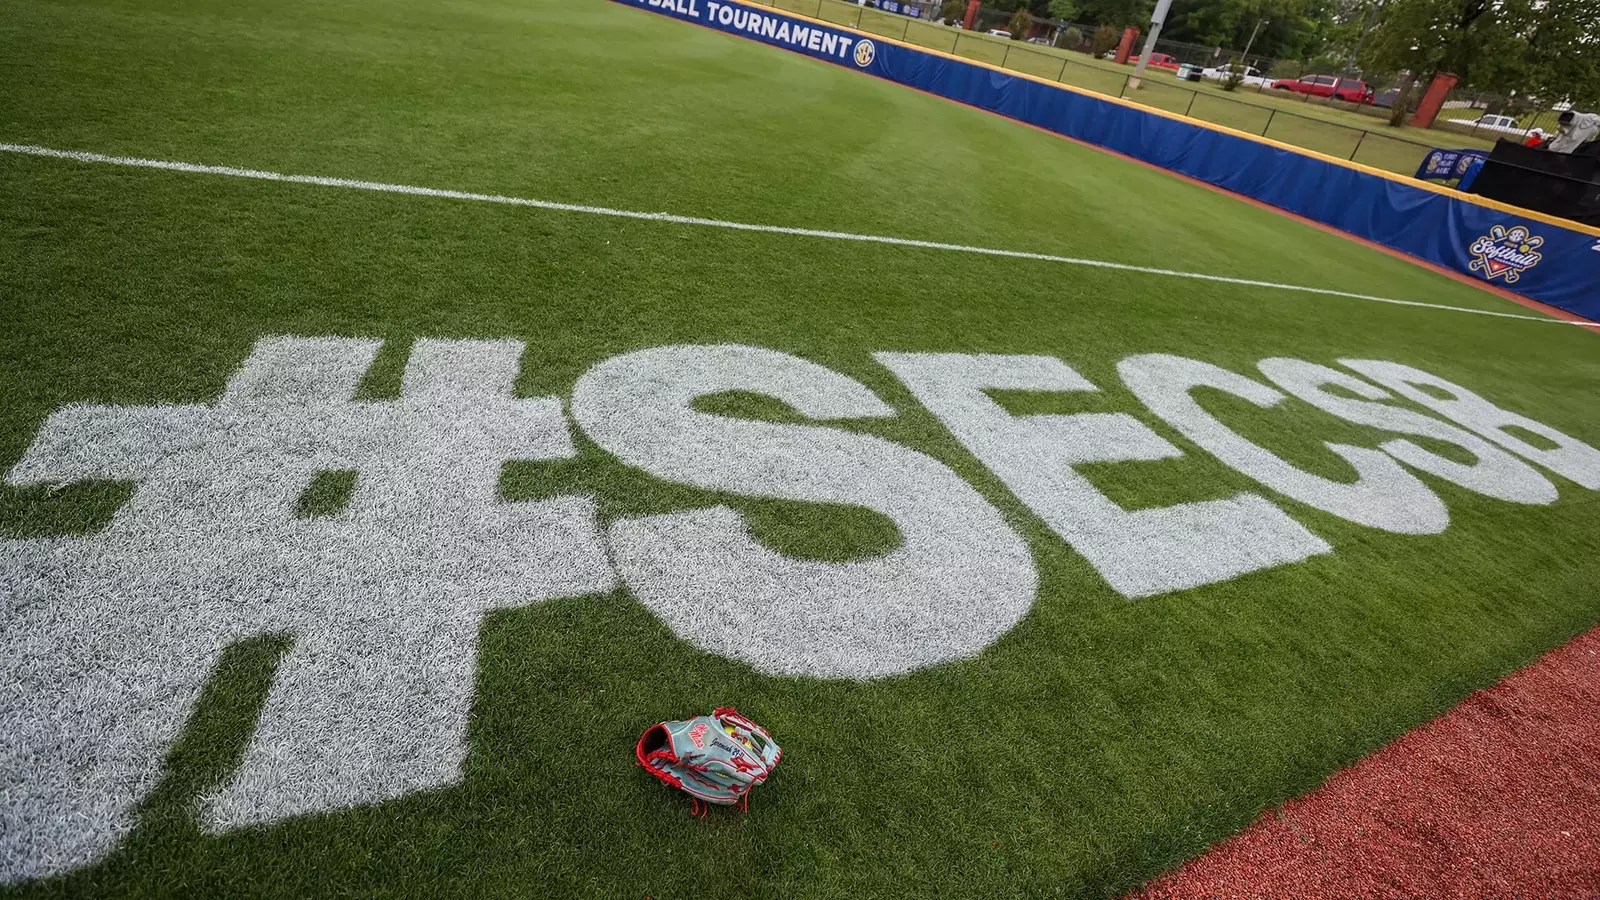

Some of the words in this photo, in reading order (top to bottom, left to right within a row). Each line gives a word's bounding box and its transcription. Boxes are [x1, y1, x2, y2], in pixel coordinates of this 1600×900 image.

[707, 2, 852, 58] TOURNAMENT
[1473, 239, 1538, 266] Softball
[0, 335, 1600, 885] #SECSB
[688, 731, 704, 749] Miss
